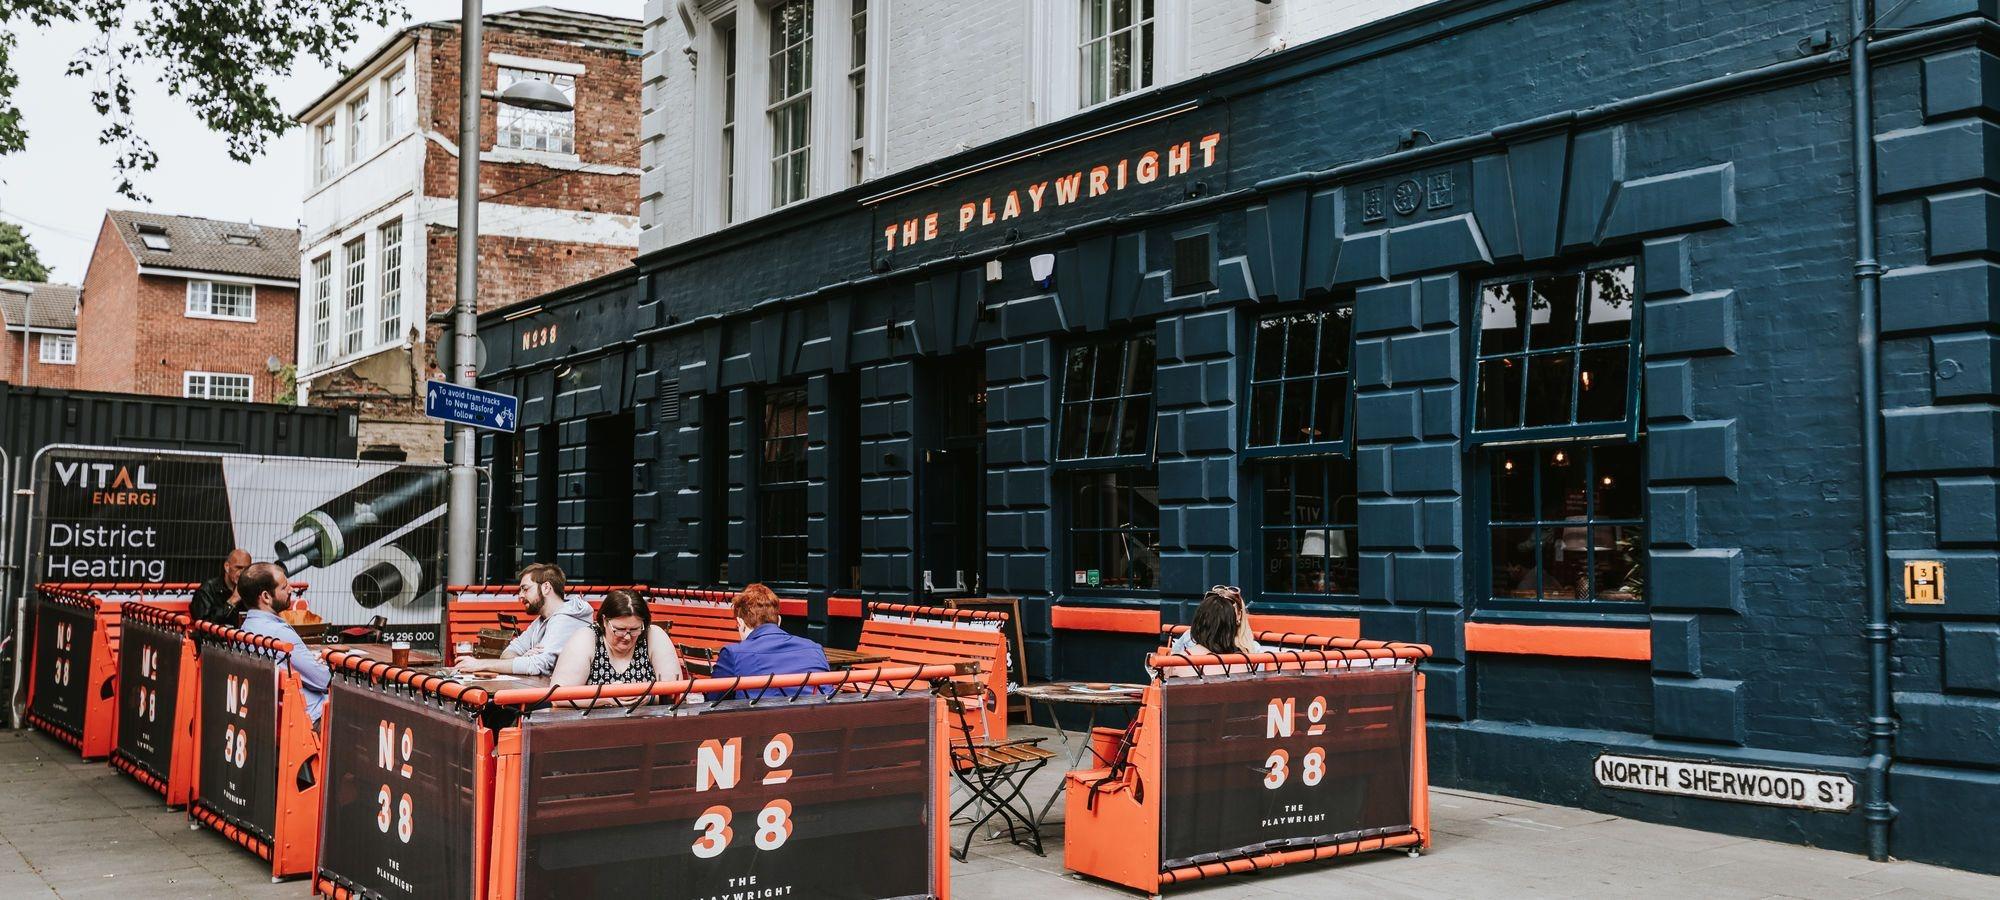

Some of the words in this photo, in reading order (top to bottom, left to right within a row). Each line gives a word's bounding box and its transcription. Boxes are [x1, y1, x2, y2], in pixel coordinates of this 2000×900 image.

[884, 212, 939, 251] THE
[959, 133, 1220, 232] PLAYWRIGHT
[439, 386, 446, 395] To
[448, 390, 465, 399] avoid
[467, 392, 480, 402] tram
[482, 396, 500, 406] tracks
[454, 400, 468, 409] New
[470, 403, 494, 414] Basford
[454, 410, 473, 420] follow
[54, 462, 156, 489] VITAL
[50, 523, 156, 547] District
[48, 554, 165, 582] Heating
[1920, 569, 1927, 577] 3
[397, 632, 414, 641] 296
[415, 631, 434, 641] 000
[55, 657, 70, 686] 38
[225, 724, 247, 769] 38
[1264, 746, 1326, 790] 38
[1601, 760, 1668, 787] NORTH
[1678, 768, 1805, 801] SHERWOOD
[378, 784, 413, 843] 38
[1285, 804, 1303, 812] THE
[692, 798, 793, 858] 38
[1262, 814, 1326, 827] PLAYWRIGHT
[389, 858, 399, 871] THE
[376, 866, 413, 893] PLAYWRIGHT
[729, 876, 756, 888] THE
[694, 886, 792, 900] YWRIGHT
